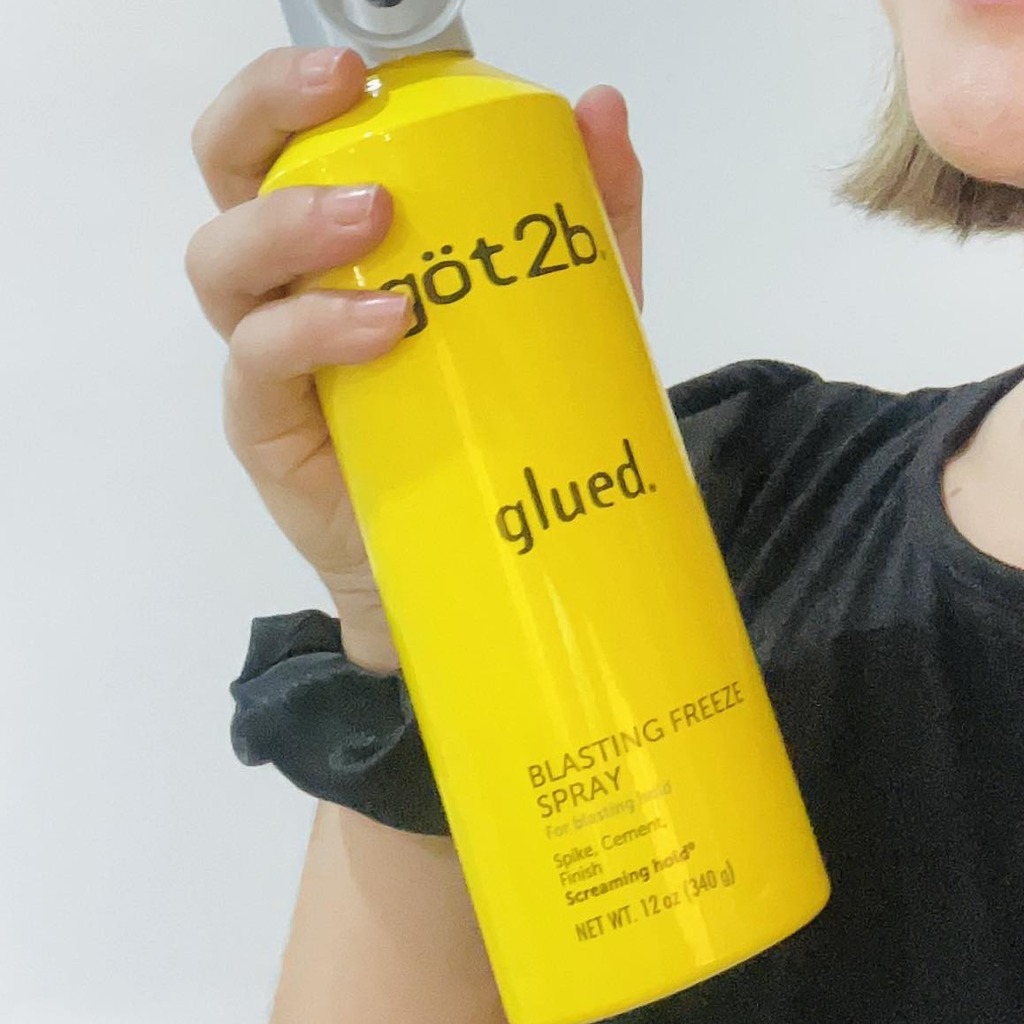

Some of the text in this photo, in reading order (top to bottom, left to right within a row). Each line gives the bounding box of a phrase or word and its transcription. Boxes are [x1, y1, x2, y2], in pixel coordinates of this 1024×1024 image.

[496, 438, 656, 555] glued.
[528, 681, 744, 788] BLASTING FREEZE
[537, 766, 621, 818] SPRAY
[559, 860, 603, 887] Finish
[565, 865, 650, 906] Screaming
[574, 859, 736, 942] NET WT. 12 oz (340 g)
